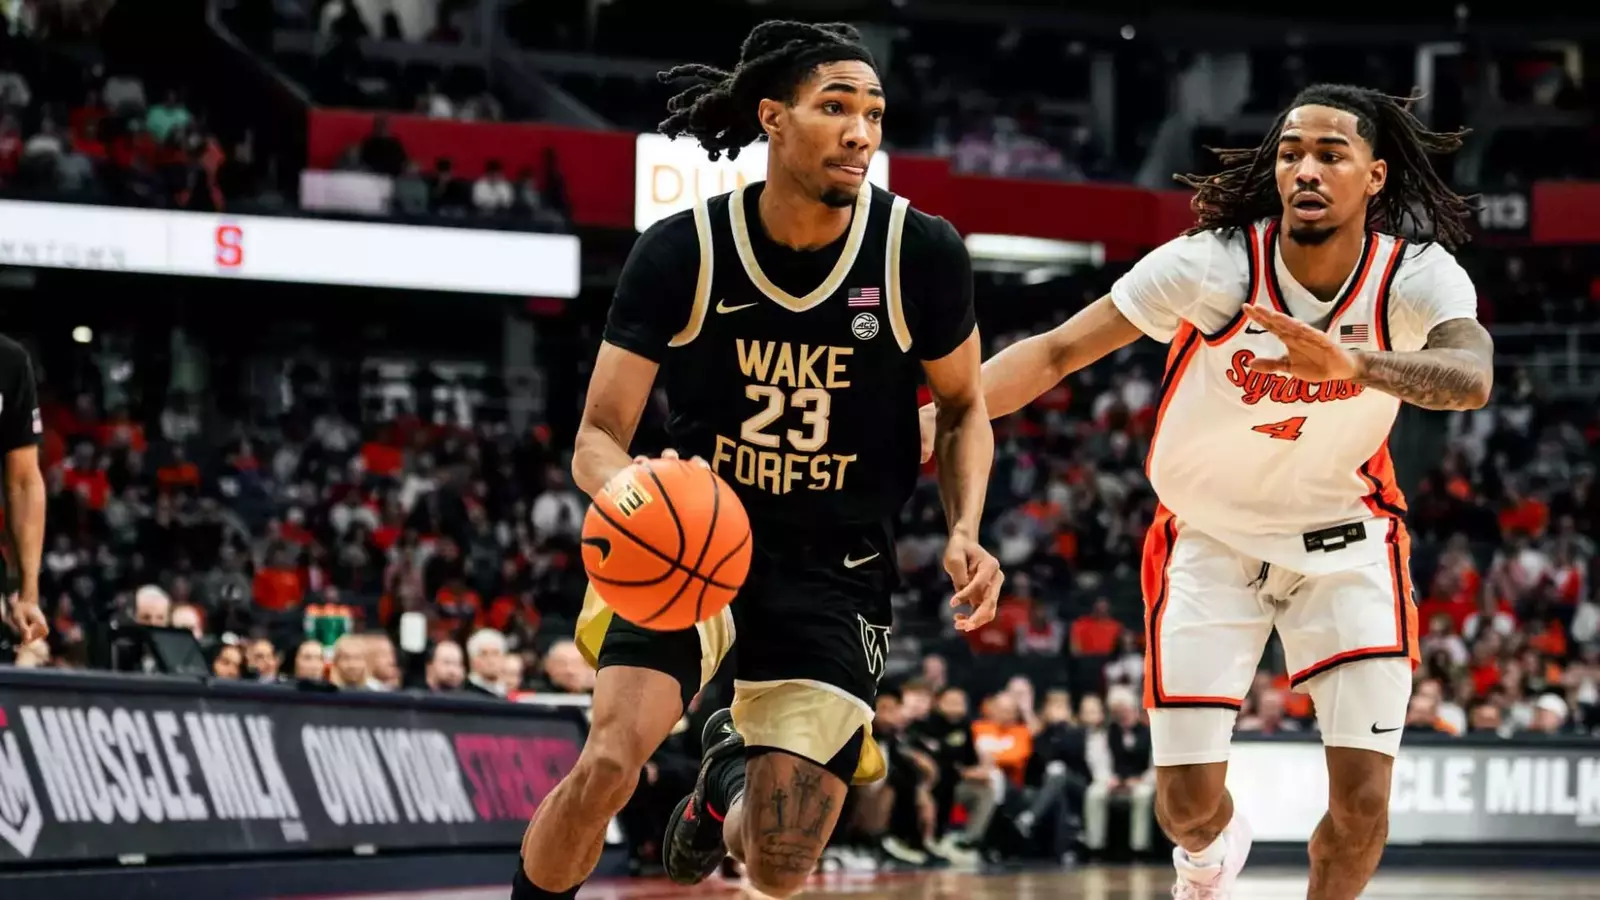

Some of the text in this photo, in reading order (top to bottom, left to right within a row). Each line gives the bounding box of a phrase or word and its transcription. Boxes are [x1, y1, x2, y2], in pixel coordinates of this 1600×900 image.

[215, 224, 244, 267] S
[736, 338, 854, 389] WAKE
[740, 384, 831, 452] 23
[1251, 416, 1308, 441] 4
[19, 706, 582, 826] MUSCLE MILK OWN YOUR STREN
[1485, 757, 1600, 815] MILK
